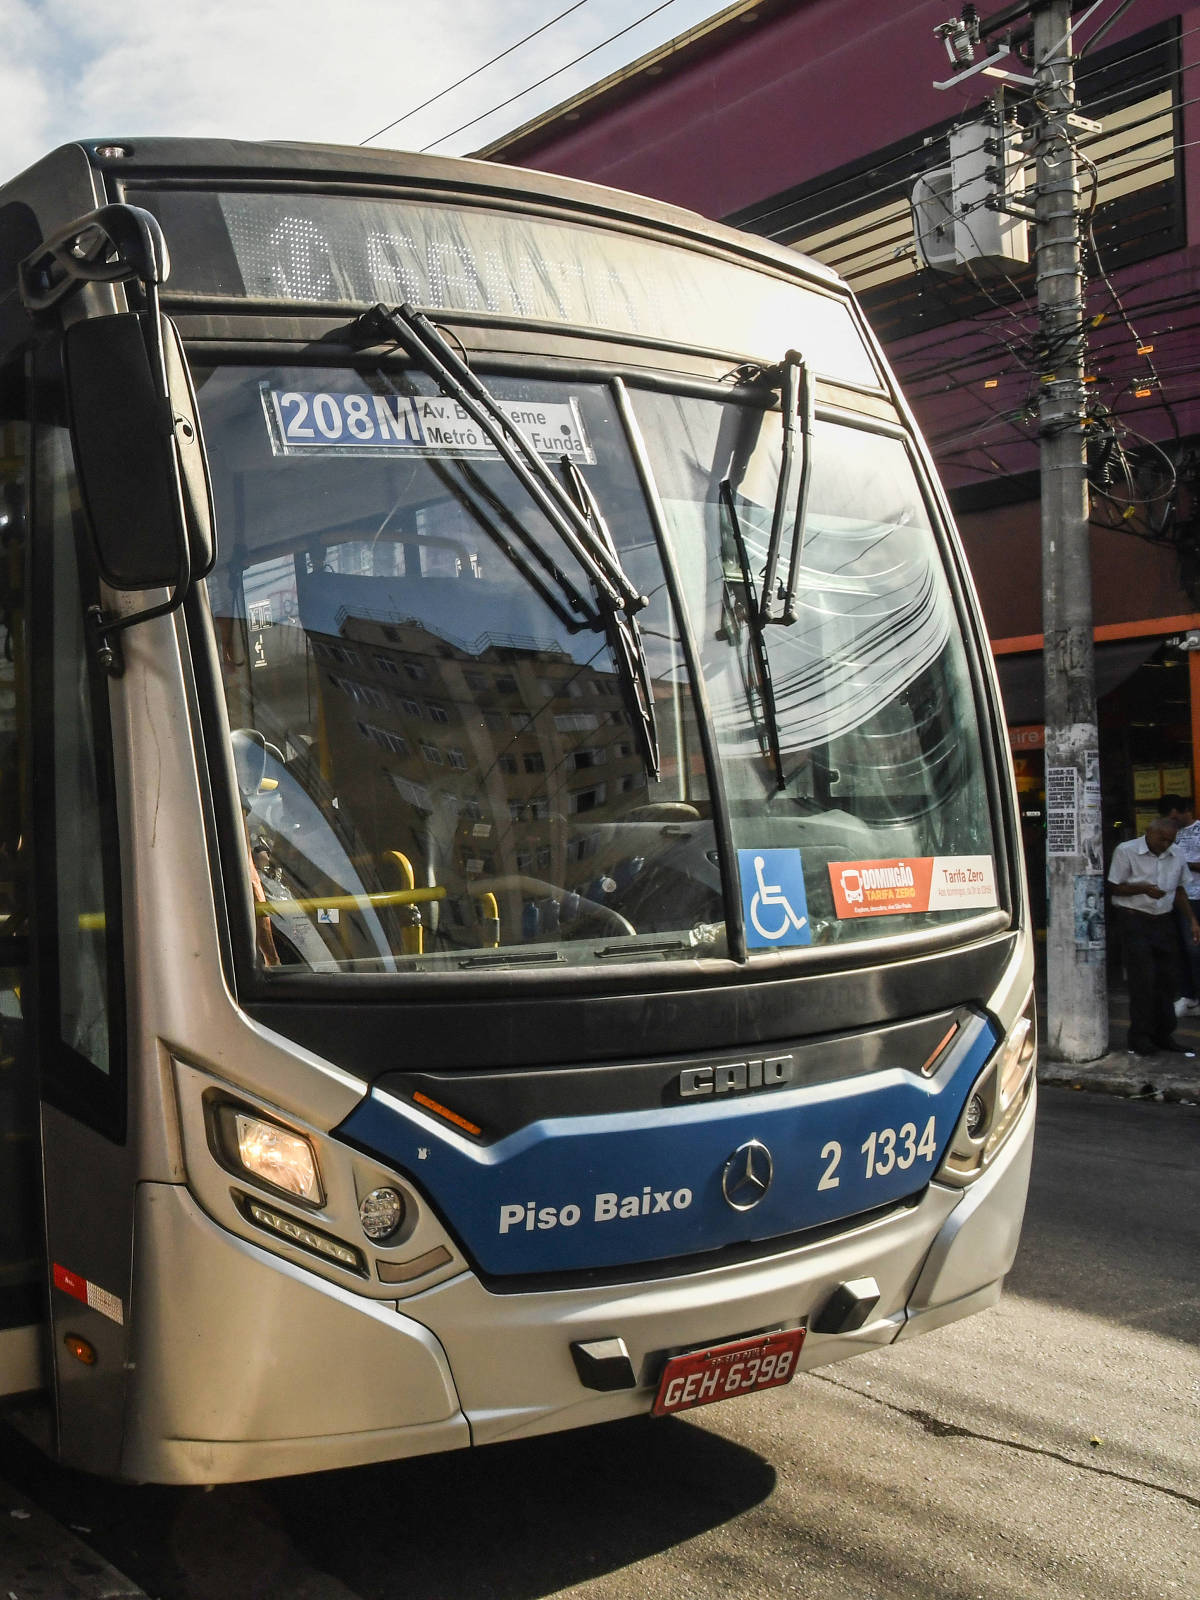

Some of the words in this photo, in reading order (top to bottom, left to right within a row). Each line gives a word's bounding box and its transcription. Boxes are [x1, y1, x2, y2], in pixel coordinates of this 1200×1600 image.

[280, 392, 420, 441] 208M
[423, 402, 450, 419] Av.
[510, 410, 547, 425] eme
[426, 427, 477, 446] Metrô
[531, 432, 583, 451] Funda
[861, 862, 914, 889] DOMINGÃO
[942, 868, 966, 883] Tarifa
[966, 868, 984, 882] Zero
[865, 889, 894, 901] TARIFA
[895, 887, 916, 898] ZERO
[679, 1054, 794, 1097] CAIO
[816, 1140, 842, 1191] 2
[860, 1115, 936, 1180] 1334
[499, 1201, 581, 1234] Piso
[594, 1186, 693, 1222] Baixo
